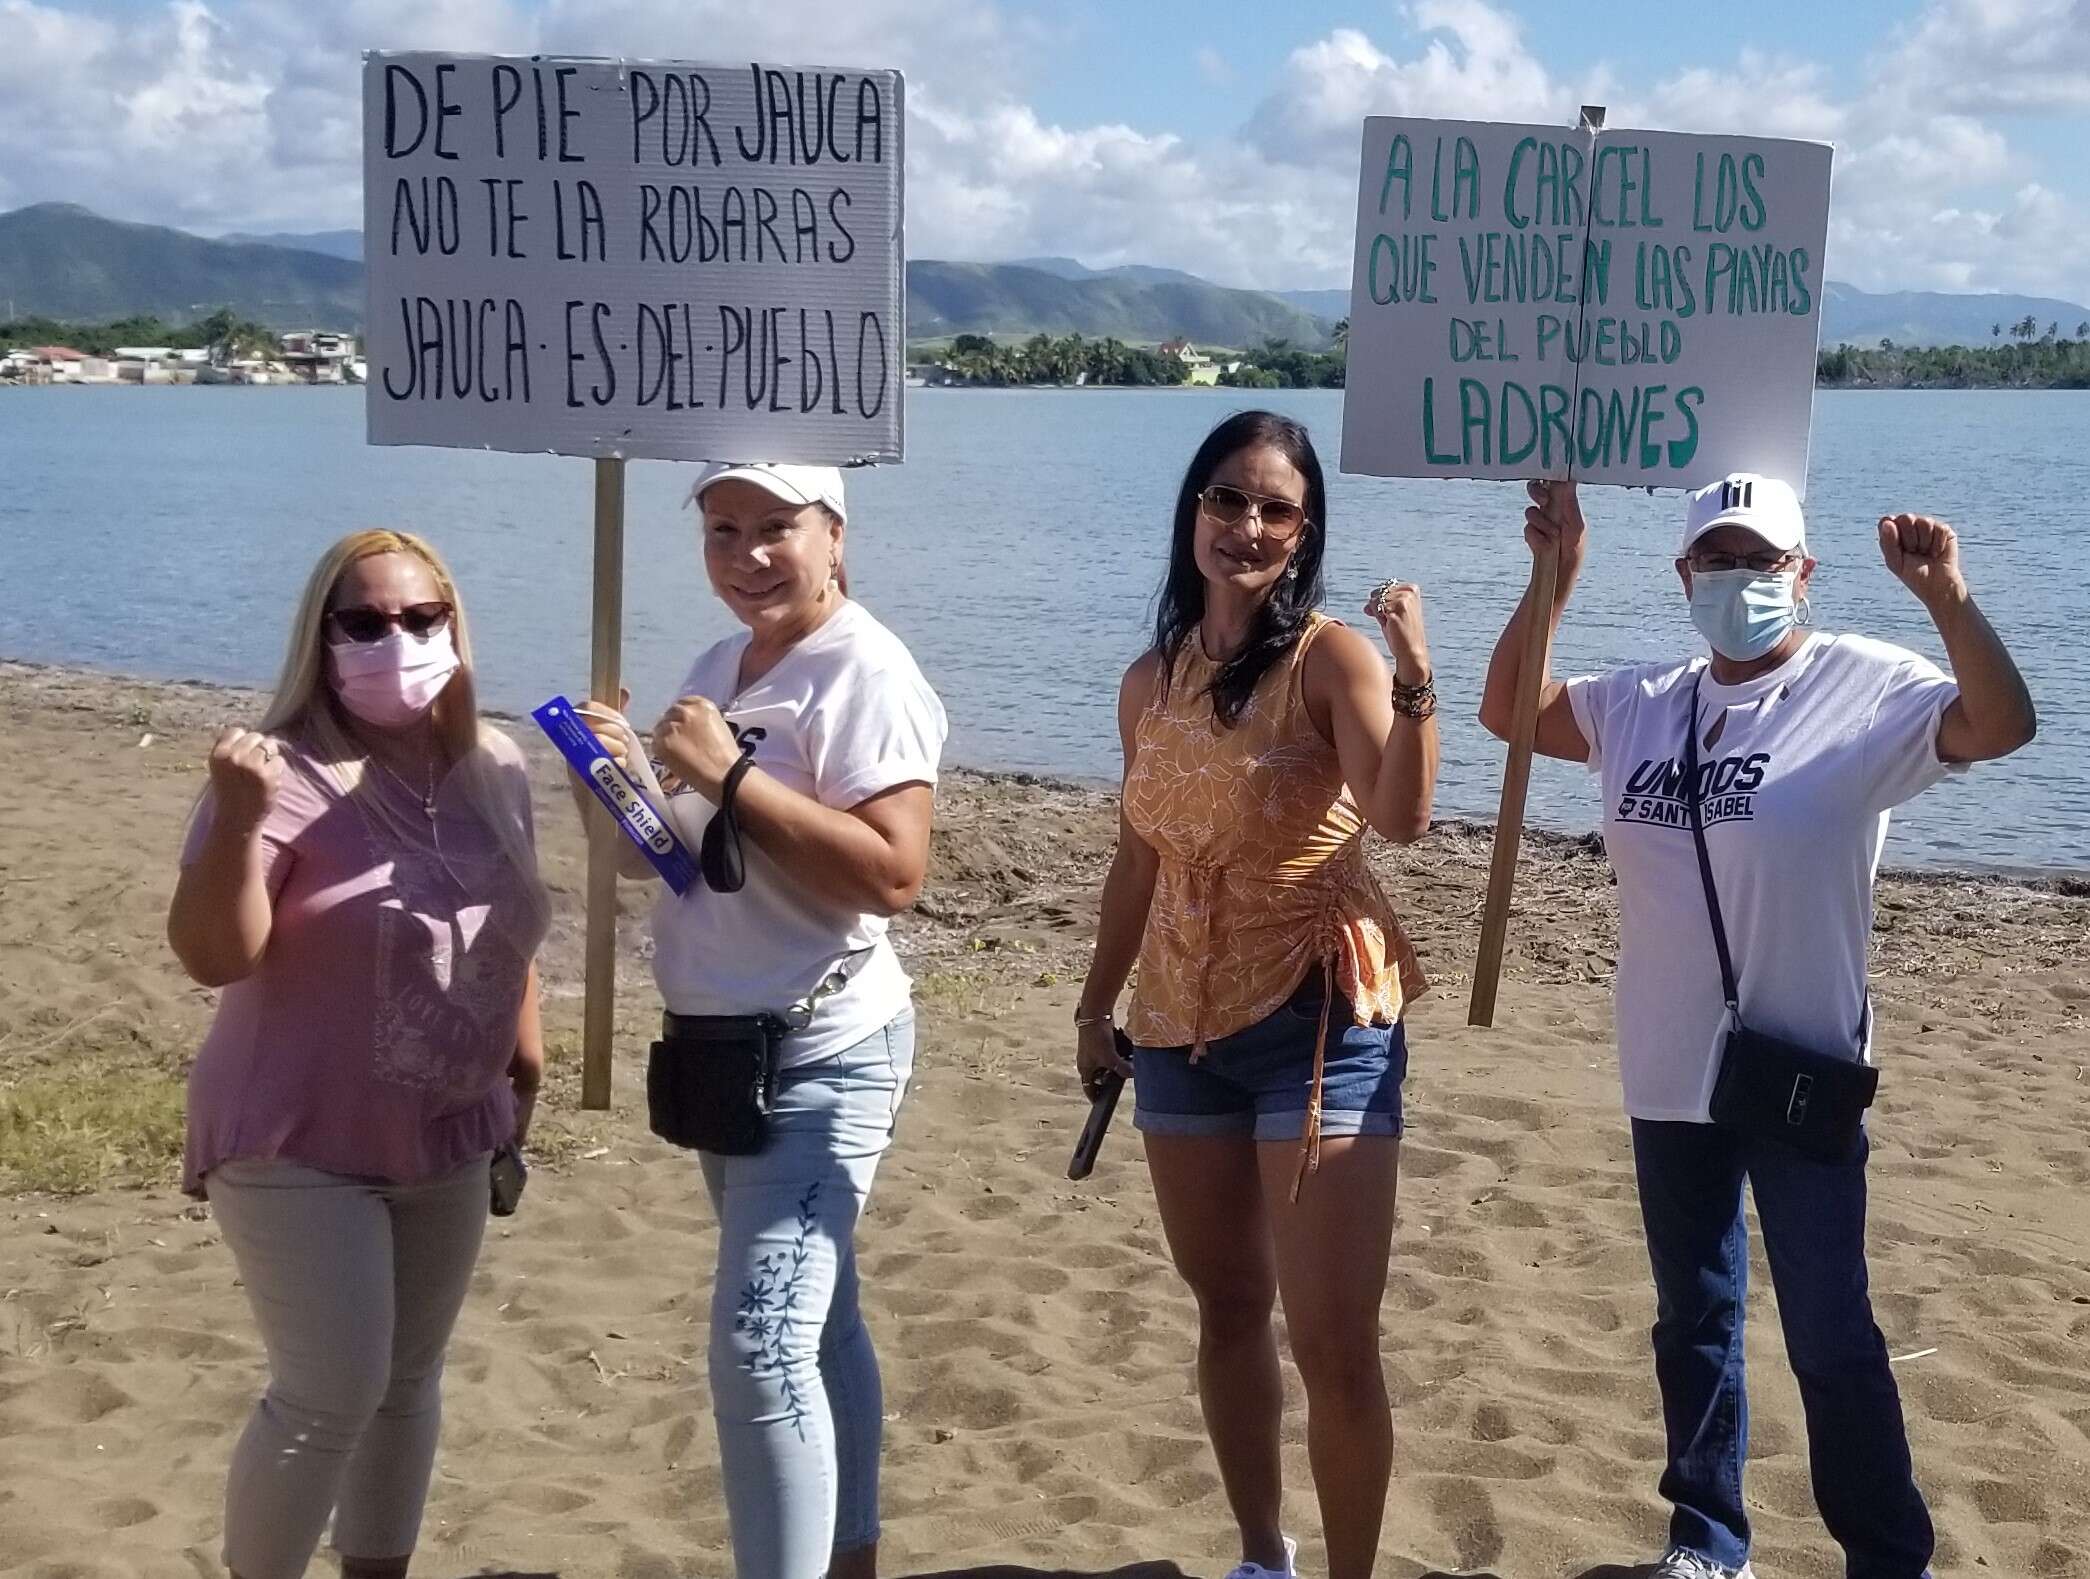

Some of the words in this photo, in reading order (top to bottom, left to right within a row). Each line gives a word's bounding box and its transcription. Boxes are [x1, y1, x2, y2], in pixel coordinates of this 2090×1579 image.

[385, 64, 461, 160] DE
[630, 70, 721, 167] POR
[735, 62, 882, 165] JAUCA
[392, 176, 460, 256] NO
[480, 178, 529, 258] TE
[553, 179, 606, 262] LA
[1379, 134, 1414, 222] A
[1432, 136, 1481, 223] LA
[1504, 136, 1665, 230] CARCEL
[1693, 151, 1767, 232] LOS
[1368, 232, 1438, 305] QUE
[1458, 232, 1612, 306] VENDEN
[1636, 241, 1696, 319] LAS
[383, 296, 530, 402] JAUCA
[566, 301, 616, 410] ES
[637, 303, 704, 410] DEL
[1449, 317, 1520, 363] DEL
[1423, 377, 1705, 470] LADRONES
[596, 764, 627, 802] Face
[625, 800, 669, 849] Shield
[1638, 802, 1690, 826] SANT
[1704, 796, 1754, 824] ISABEL
